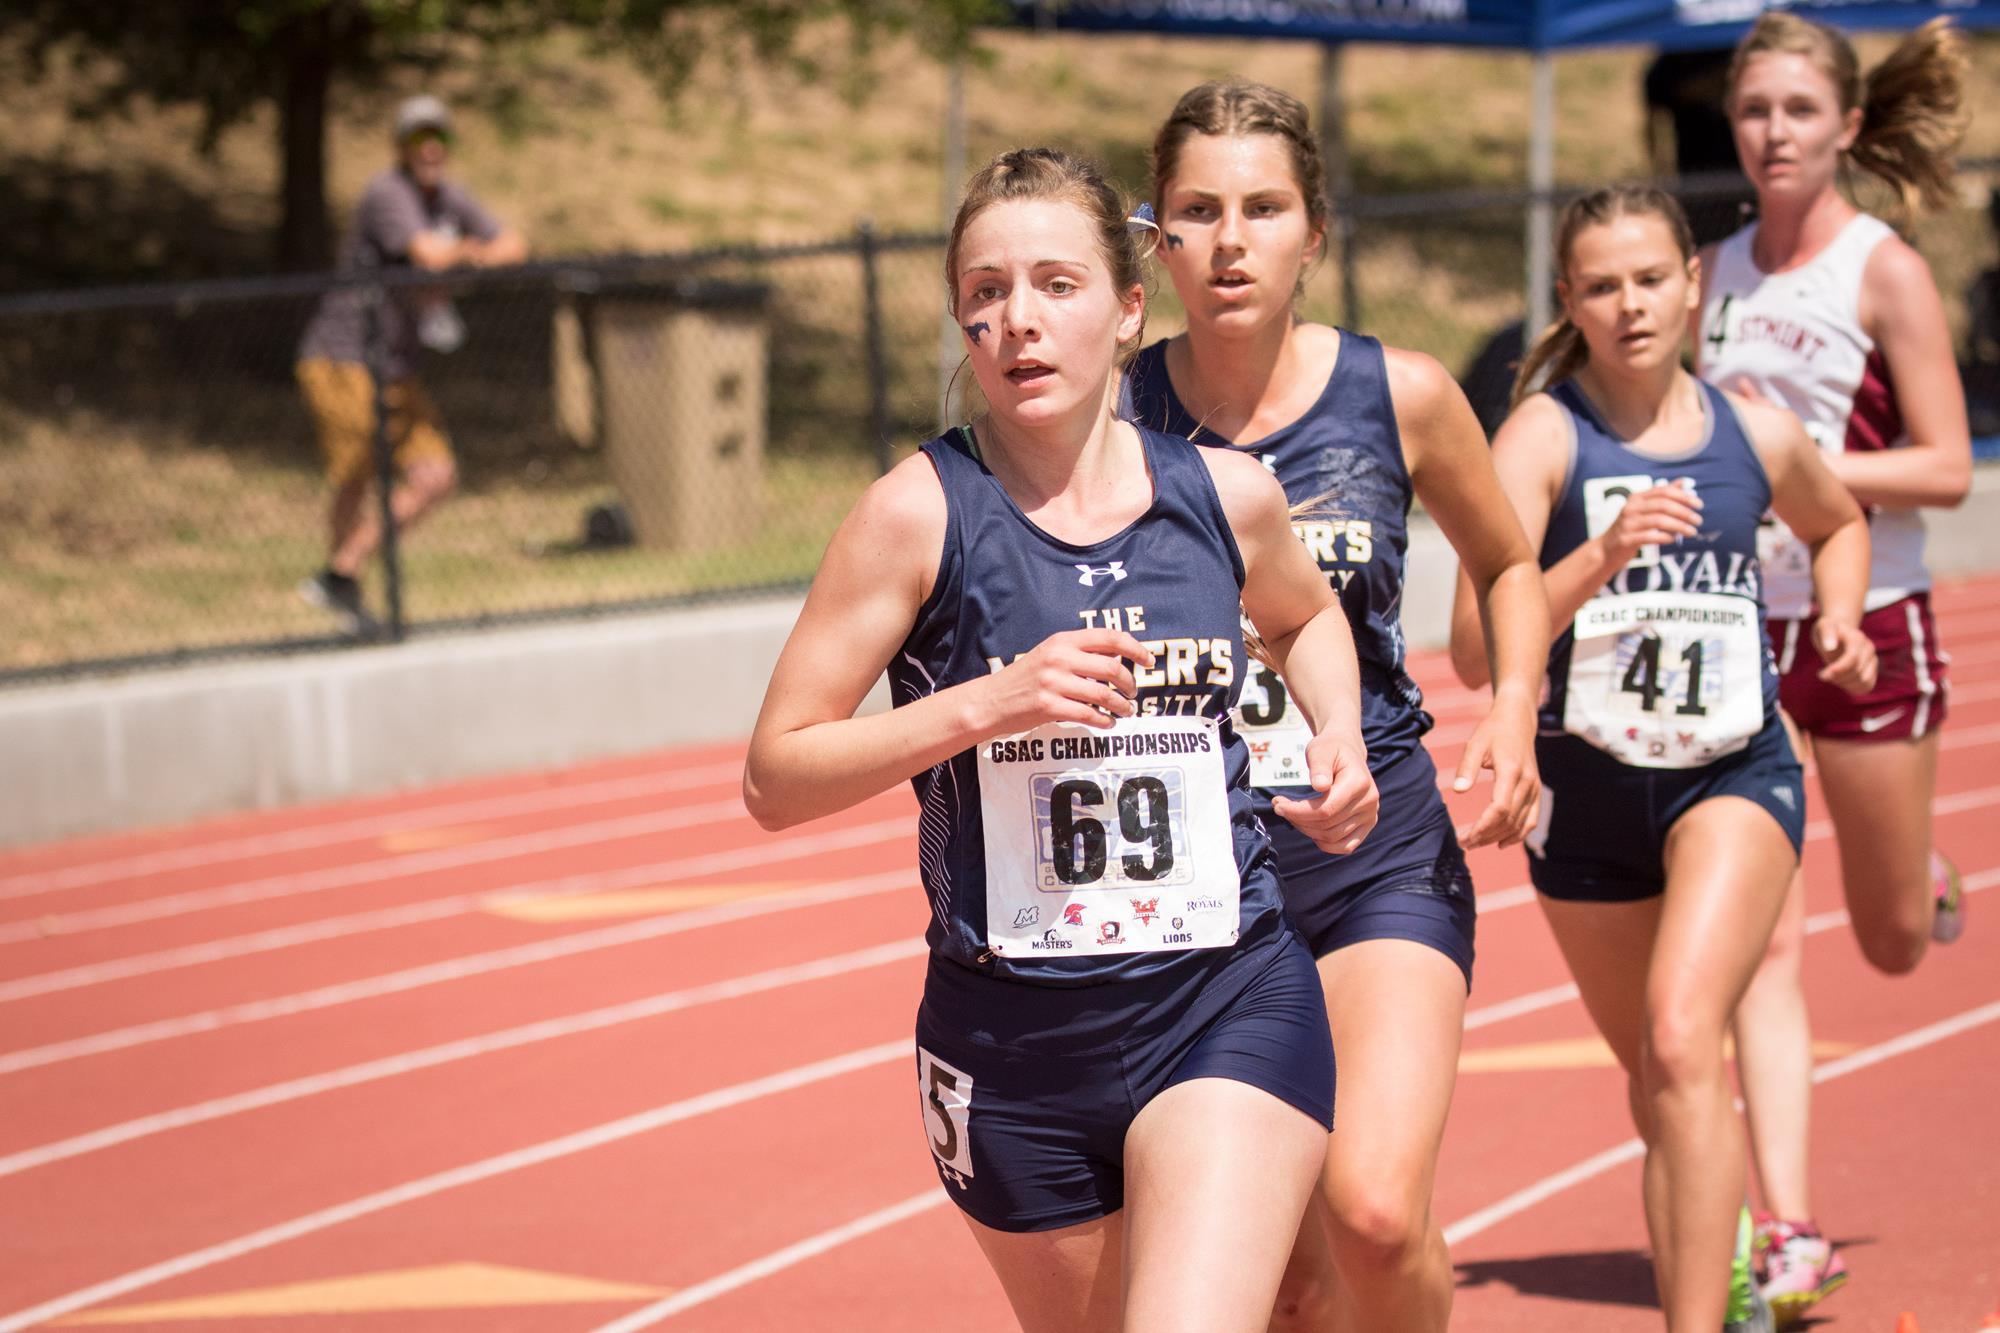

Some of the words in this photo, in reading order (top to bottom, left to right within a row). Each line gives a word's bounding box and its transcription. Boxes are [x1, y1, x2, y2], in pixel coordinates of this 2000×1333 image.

[1737, 315, 1827, 362] STMONT
[1599, 550, 1758, 600] OYALS
[1079, 606, 1146, 632] THE
[1241, 664, 1286, 727] 3
[1621, 637, 1707, 716] 41
[991, 739, 1044, 763] GSAC
[1050, 732, 1211, 760] CHAMPIONSHIPS
[1050, 776, 1174, 885] 69
[1187, 900, 1223, 911] ROYALS
[1032, 940, 1073, 950] MASTER'S
[929, 1061, 957, 1161] 5
